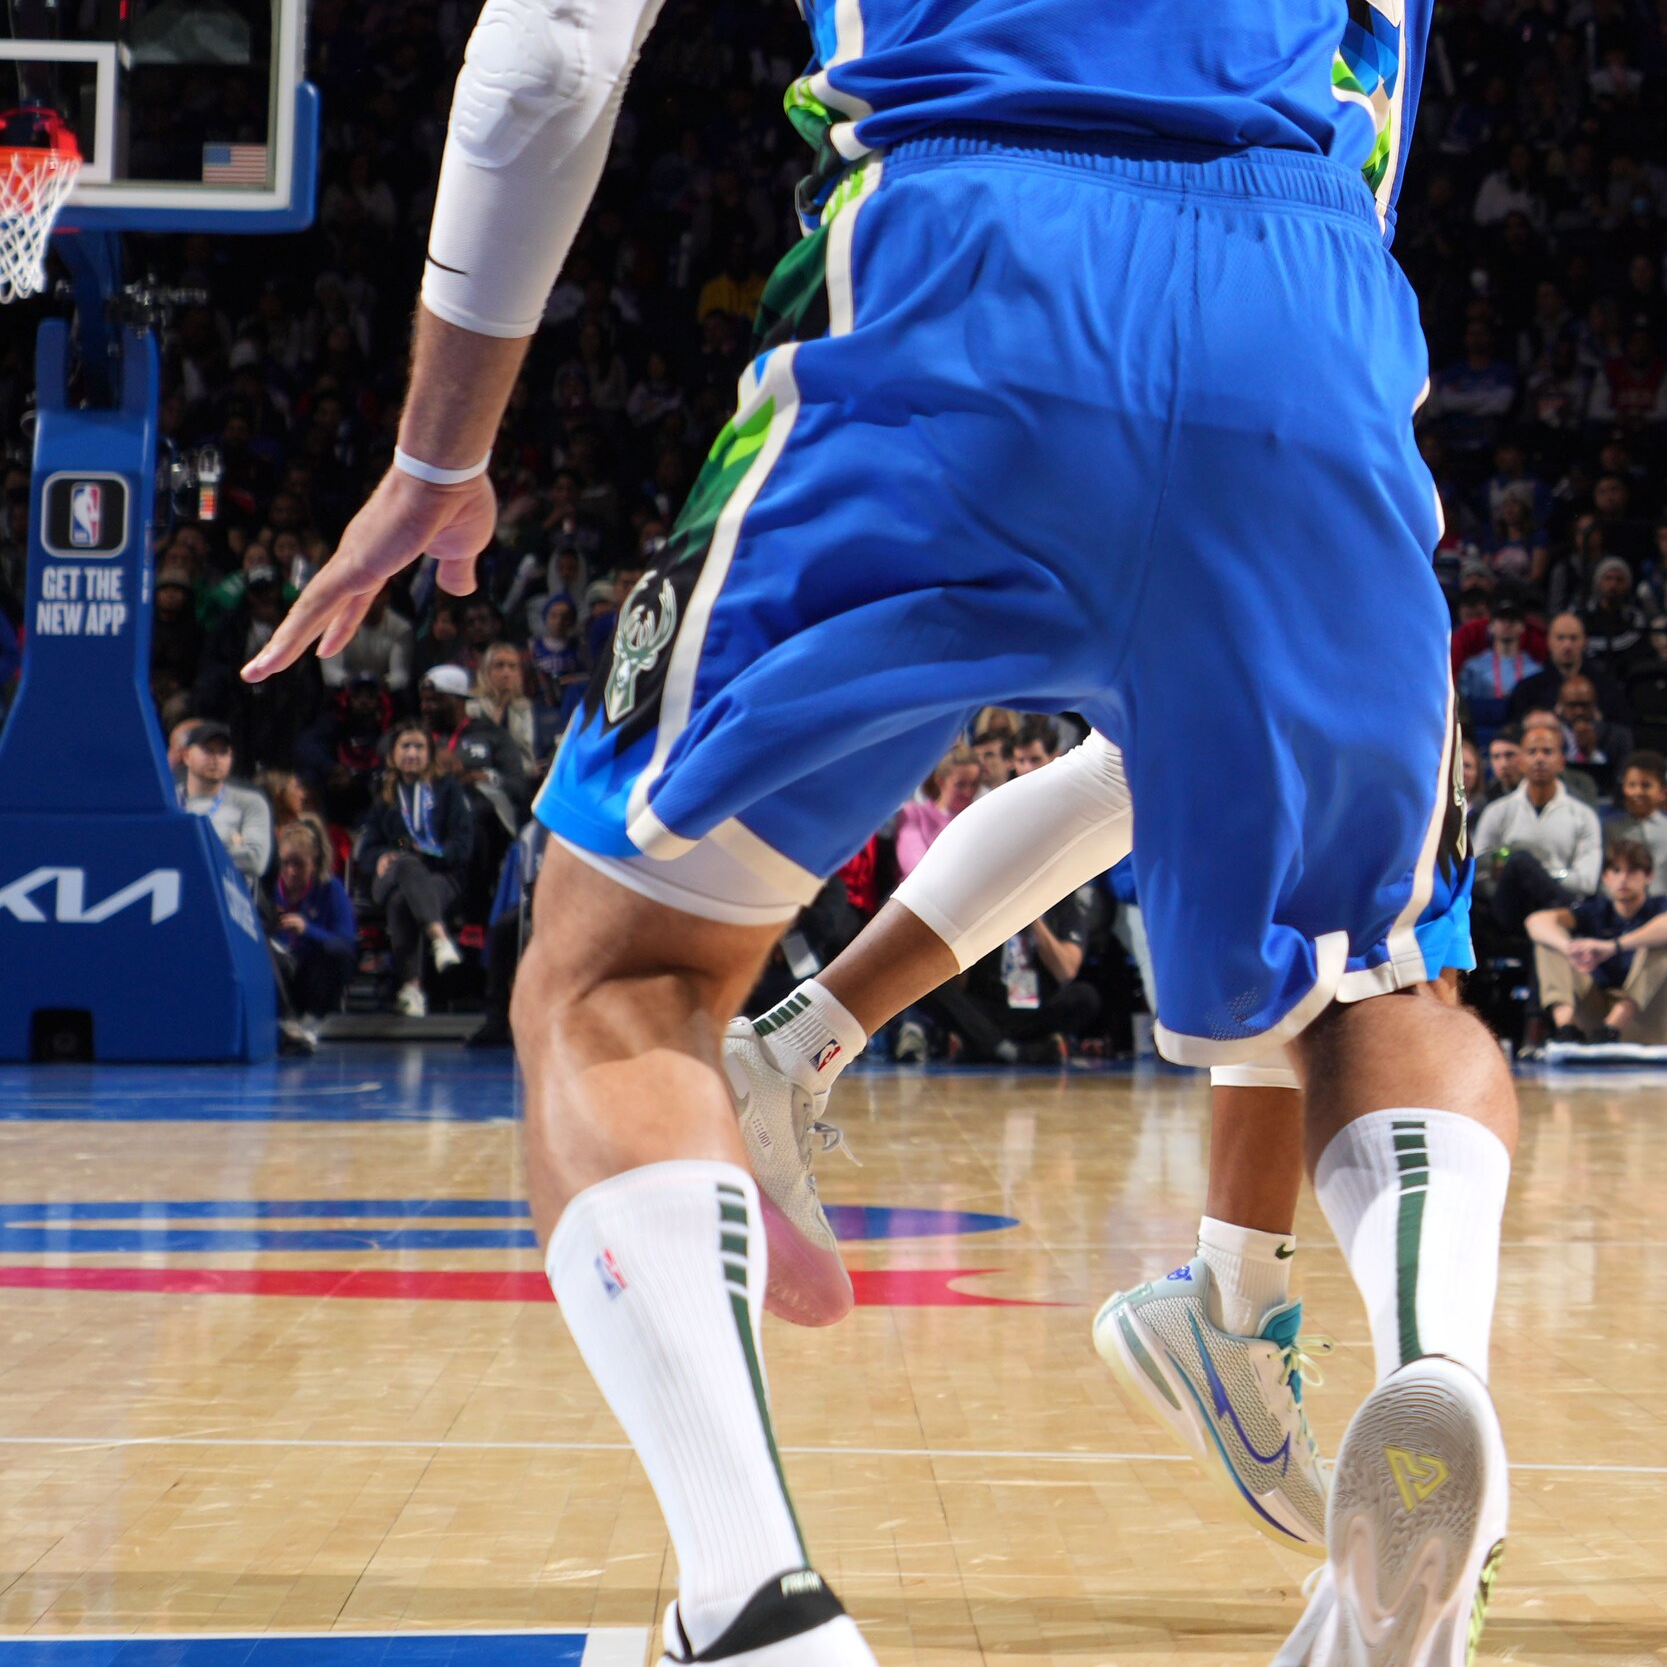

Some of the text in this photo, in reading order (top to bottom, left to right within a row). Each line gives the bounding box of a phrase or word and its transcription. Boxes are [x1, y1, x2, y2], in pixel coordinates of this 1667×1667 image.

[41, 566, 125, 601] GET THE
[36, 601, 127, 637] NEW APP
